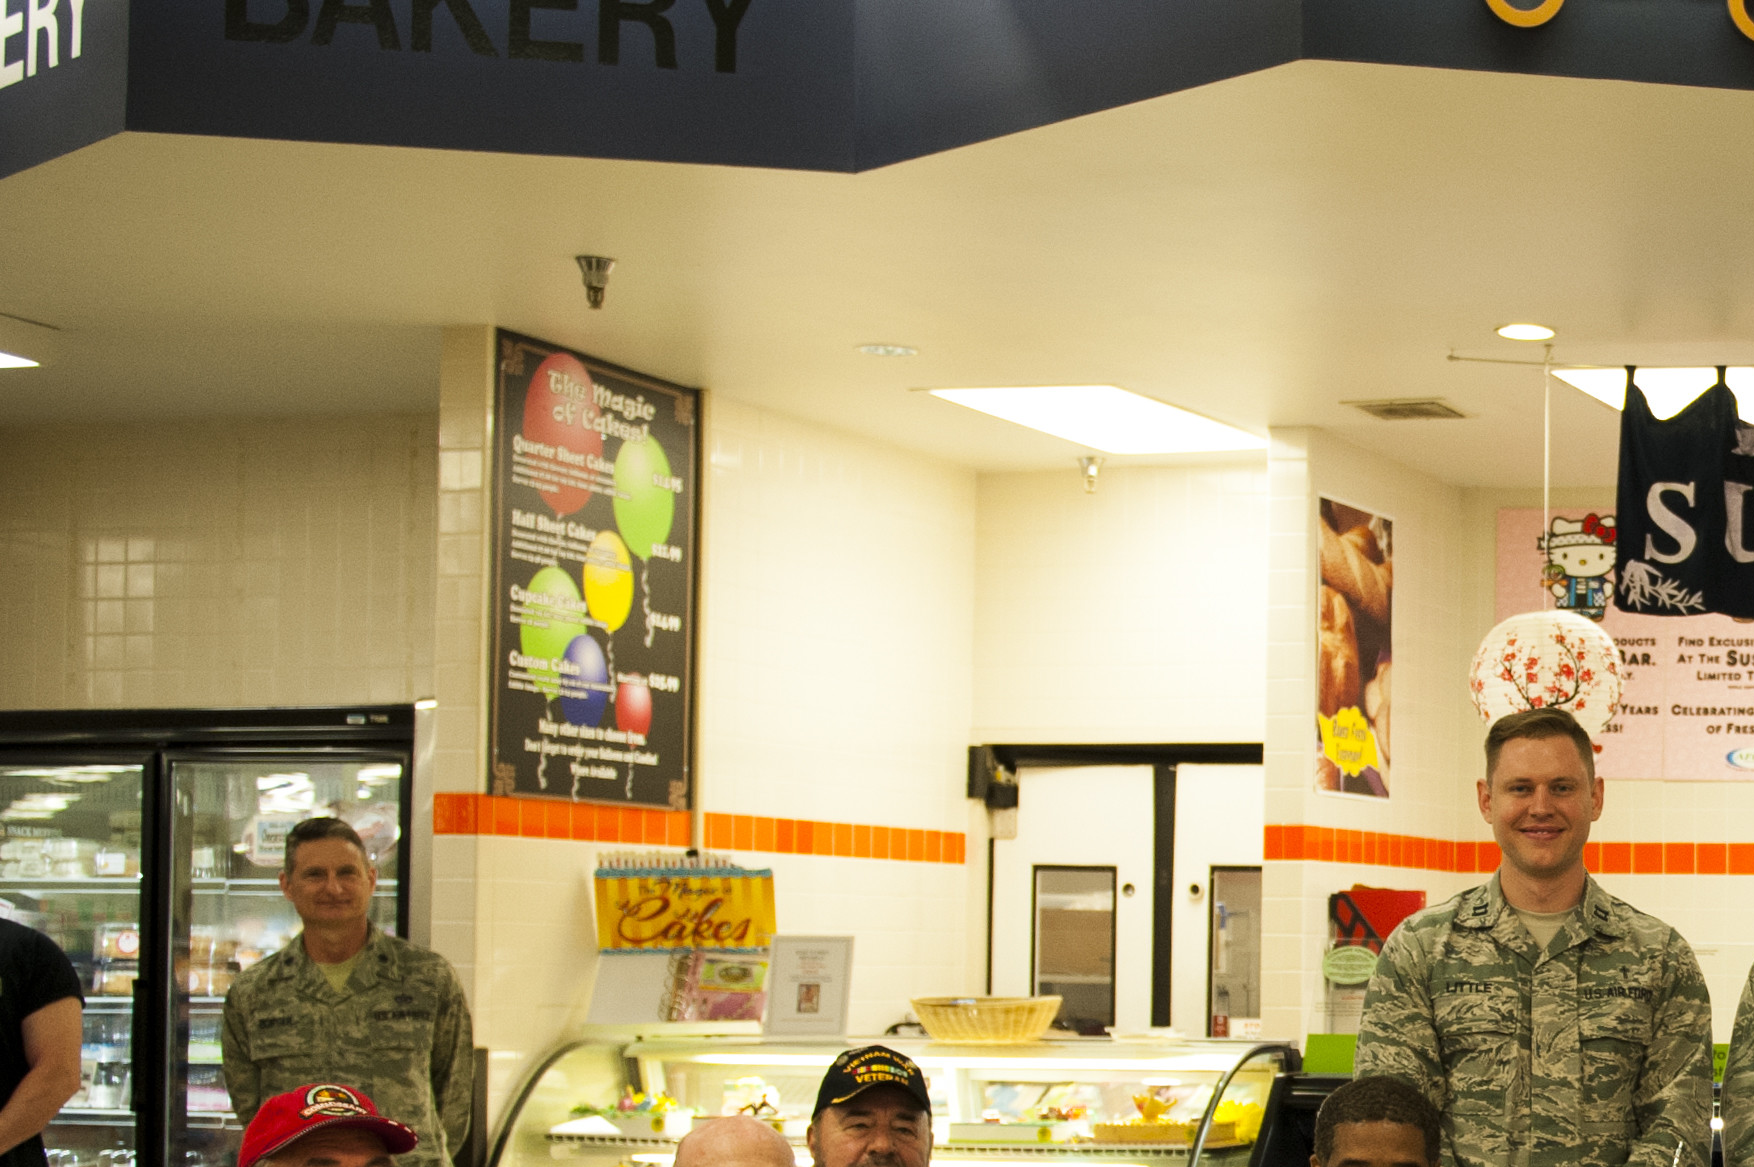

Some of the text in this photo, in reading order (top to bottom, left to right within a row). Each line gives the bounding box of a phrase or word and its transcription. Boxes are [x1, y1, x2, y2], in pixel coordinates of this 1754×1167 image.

[548, 370, 656, 421] The Magic
[553, 404, 650, 443] of Cakes!
[513, 433, 555, 460] Quarter
[511, 508, 536, 529] Half
[1678, 636, 1704, 647] FIND
[1677, 653, 1694, 665] AT
[1699, 653, 1721, 665] THE
[1697, 671, 1742, 682] LIMITED
[1621, 704, 1659, 716] YEARS
[1671, 704, 1754, 717] CELEBRATING
[1706, 725, 1721, 735] OF
[617, 896, 752, 946] Cakes
[1446, 980, 1493, 994] LITTLE
[1607, 986, 1626, 998] AIR
